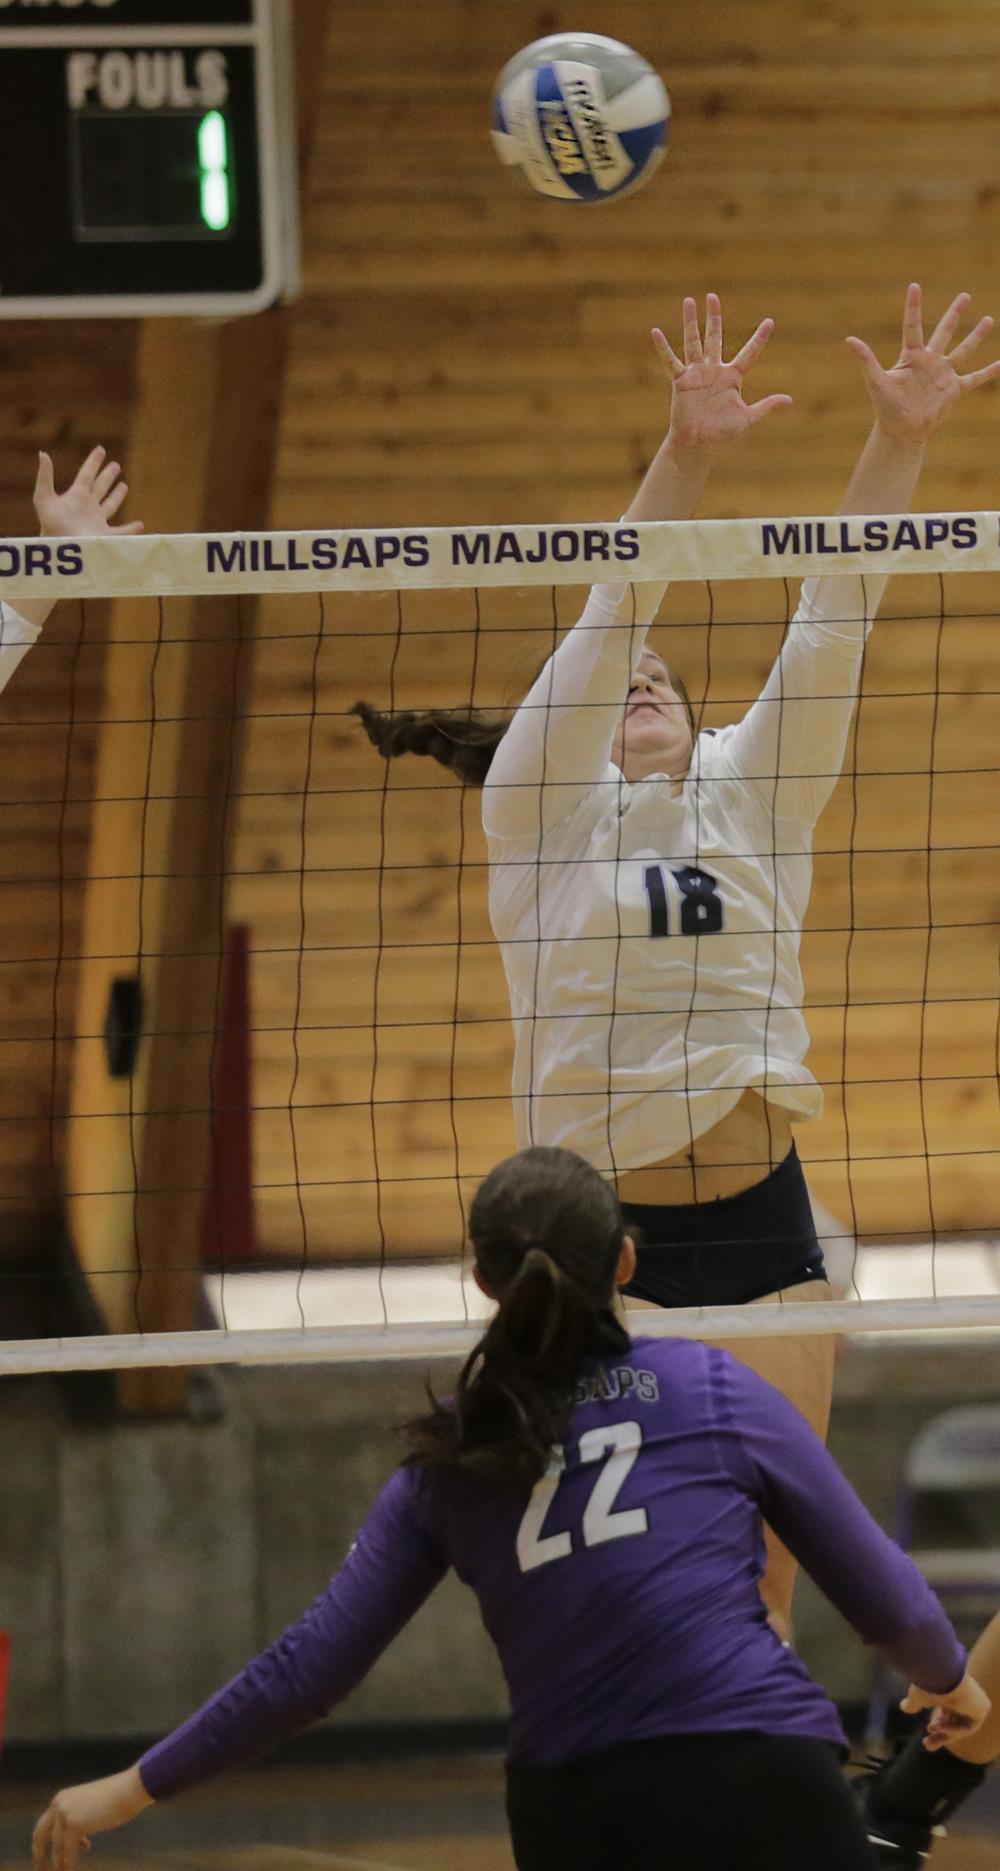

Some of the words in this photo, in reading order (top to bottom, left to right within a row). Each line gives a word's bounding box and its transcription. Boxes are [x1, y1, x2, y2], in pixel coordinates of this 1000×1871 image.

[66, 50, 229, 109] FOULS
[198, 110, 229, 230] 1
[206, 535, 430, 573] MILLSAPS
[451, 529, 640, 565] MAJORS
[762, 517, 978, 555] MILLSAPS
[644, 864, 723, 938] 18
[516, 1420, 648, 1573] 22
